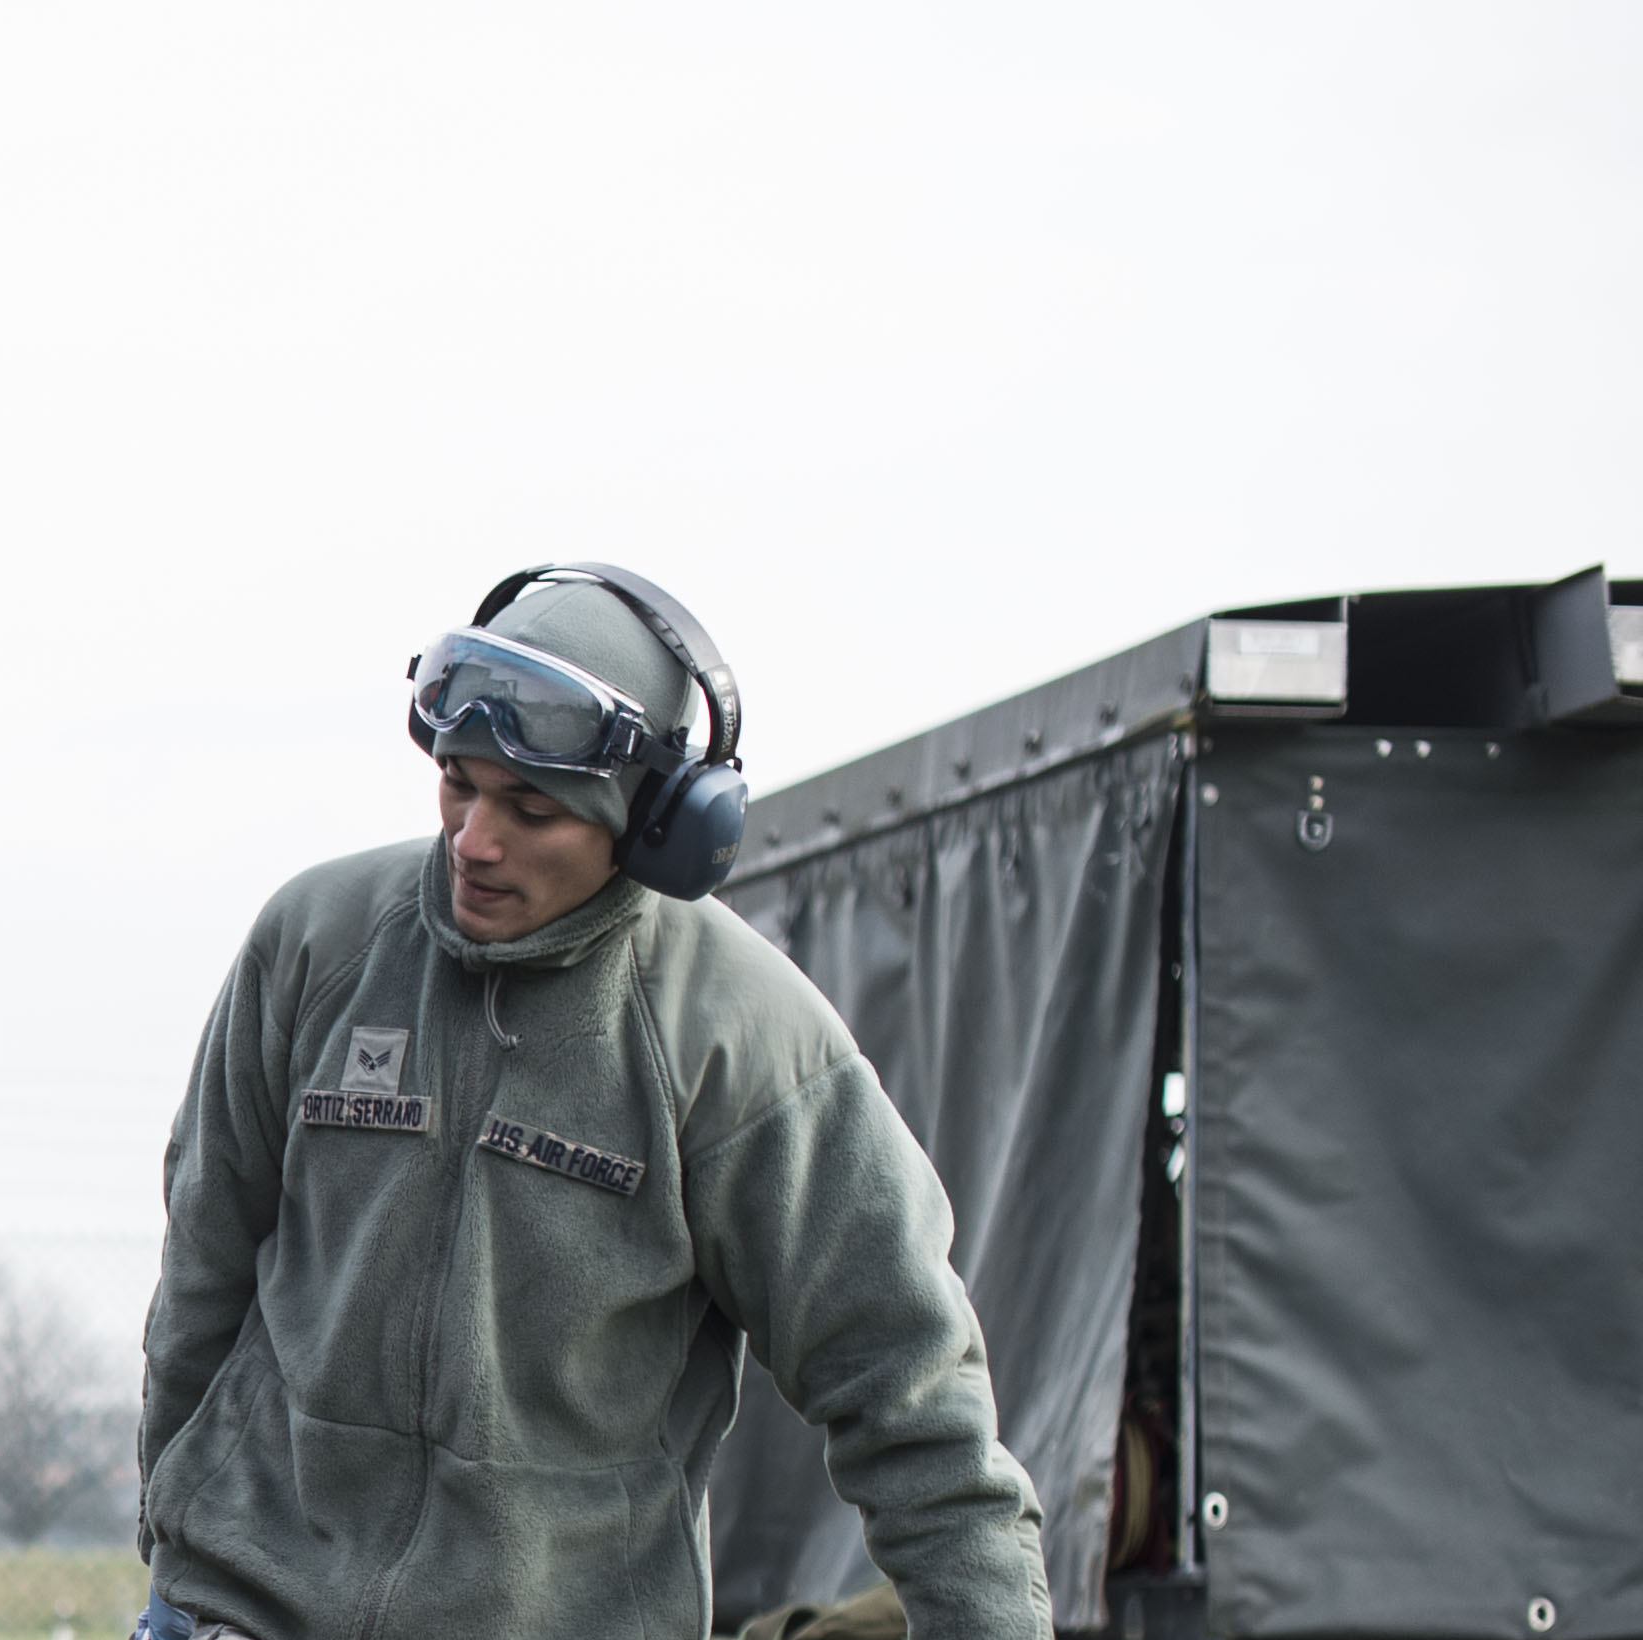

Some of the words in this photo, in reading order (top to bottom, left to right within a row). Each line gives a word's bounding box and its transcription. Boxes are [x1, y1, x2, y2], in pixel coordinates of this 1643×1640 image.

[304, 1094, 345, 1122] ORTIZ
[352, 1097, 422, 1128] SERRANO
[526, 1135, 566, 1169] AIR
[567, 1148, 638, 1192] FORCE
